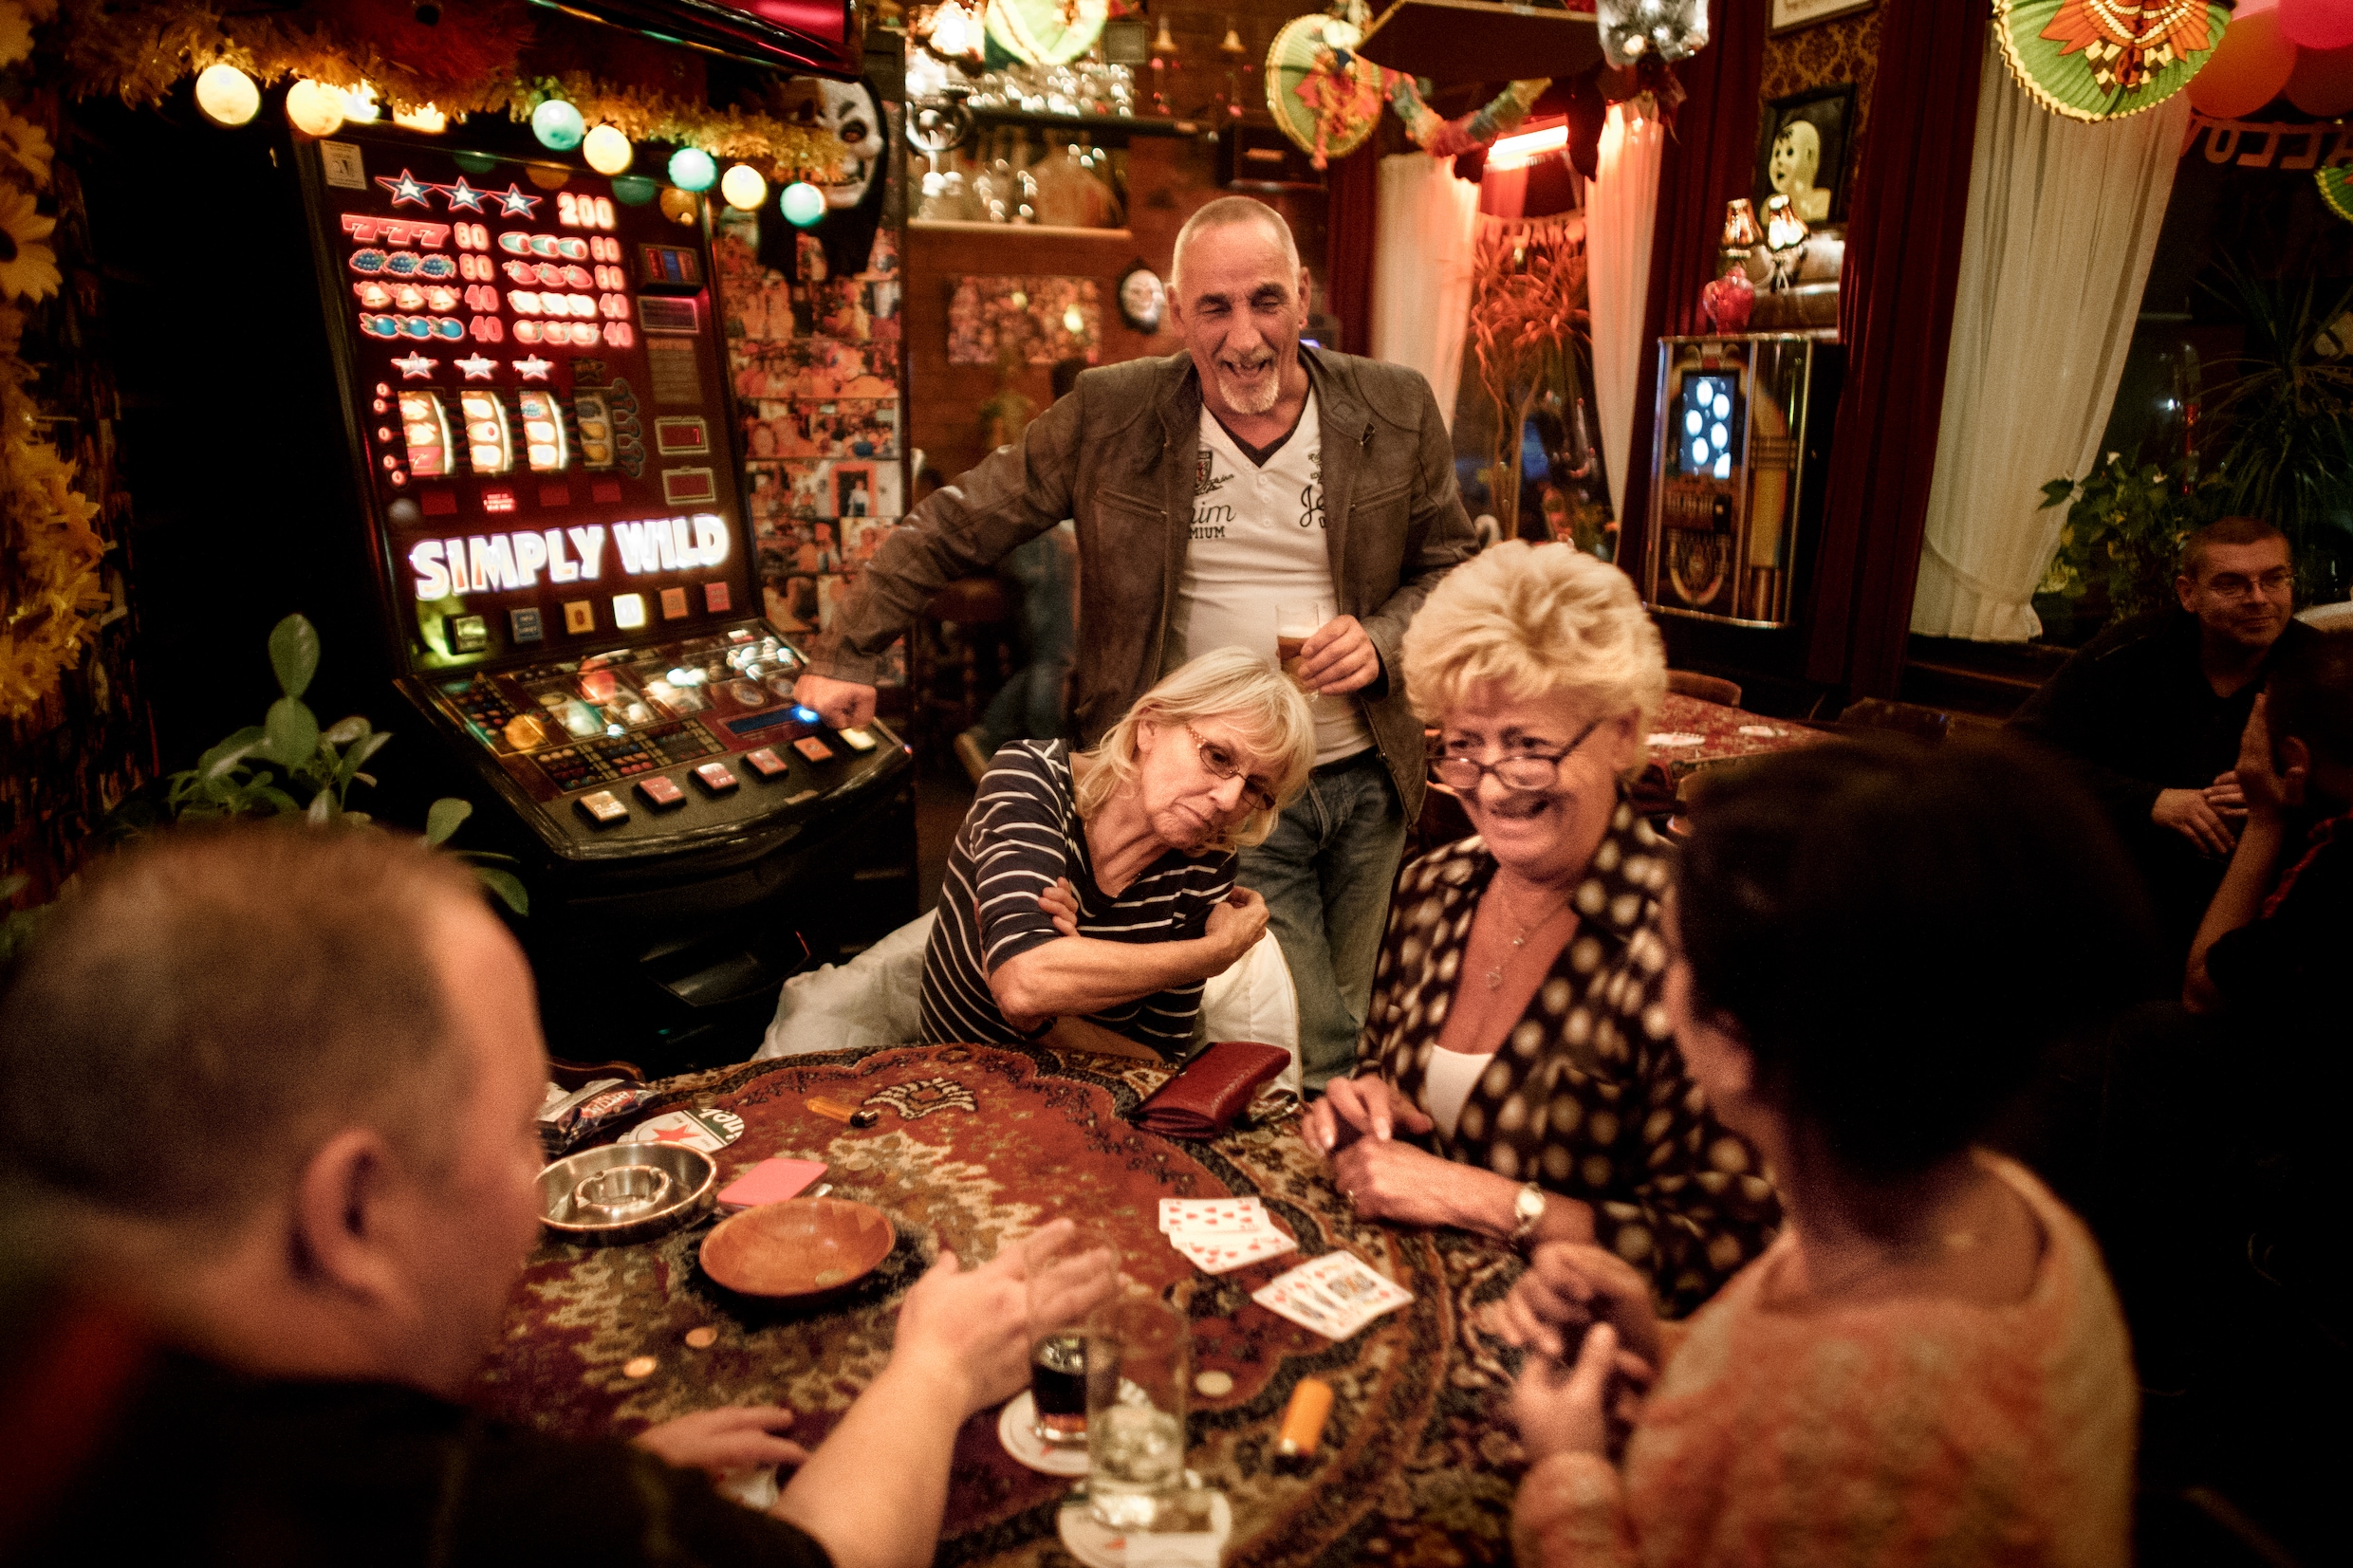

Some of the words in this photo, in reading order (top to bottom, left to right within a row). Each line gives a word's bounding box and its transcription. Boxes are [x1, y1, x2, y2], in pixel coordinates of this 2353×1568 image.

[557, 193, 614, 229] 200
[454, 222, 490, 250] 80
[590, 235, 621, 263] 80
[459, 253, 494, 283] 80
[594, 264, 624, 291] 80
[465, 285, 500, 311] 40
[599, 292, 629, 320] 40
[470, 316, 505, 342] 40
[603, 322, 634, 348] 40
[411, 525, 604, 601] SIMPLY
[612, 513, 731, 574] WILD
